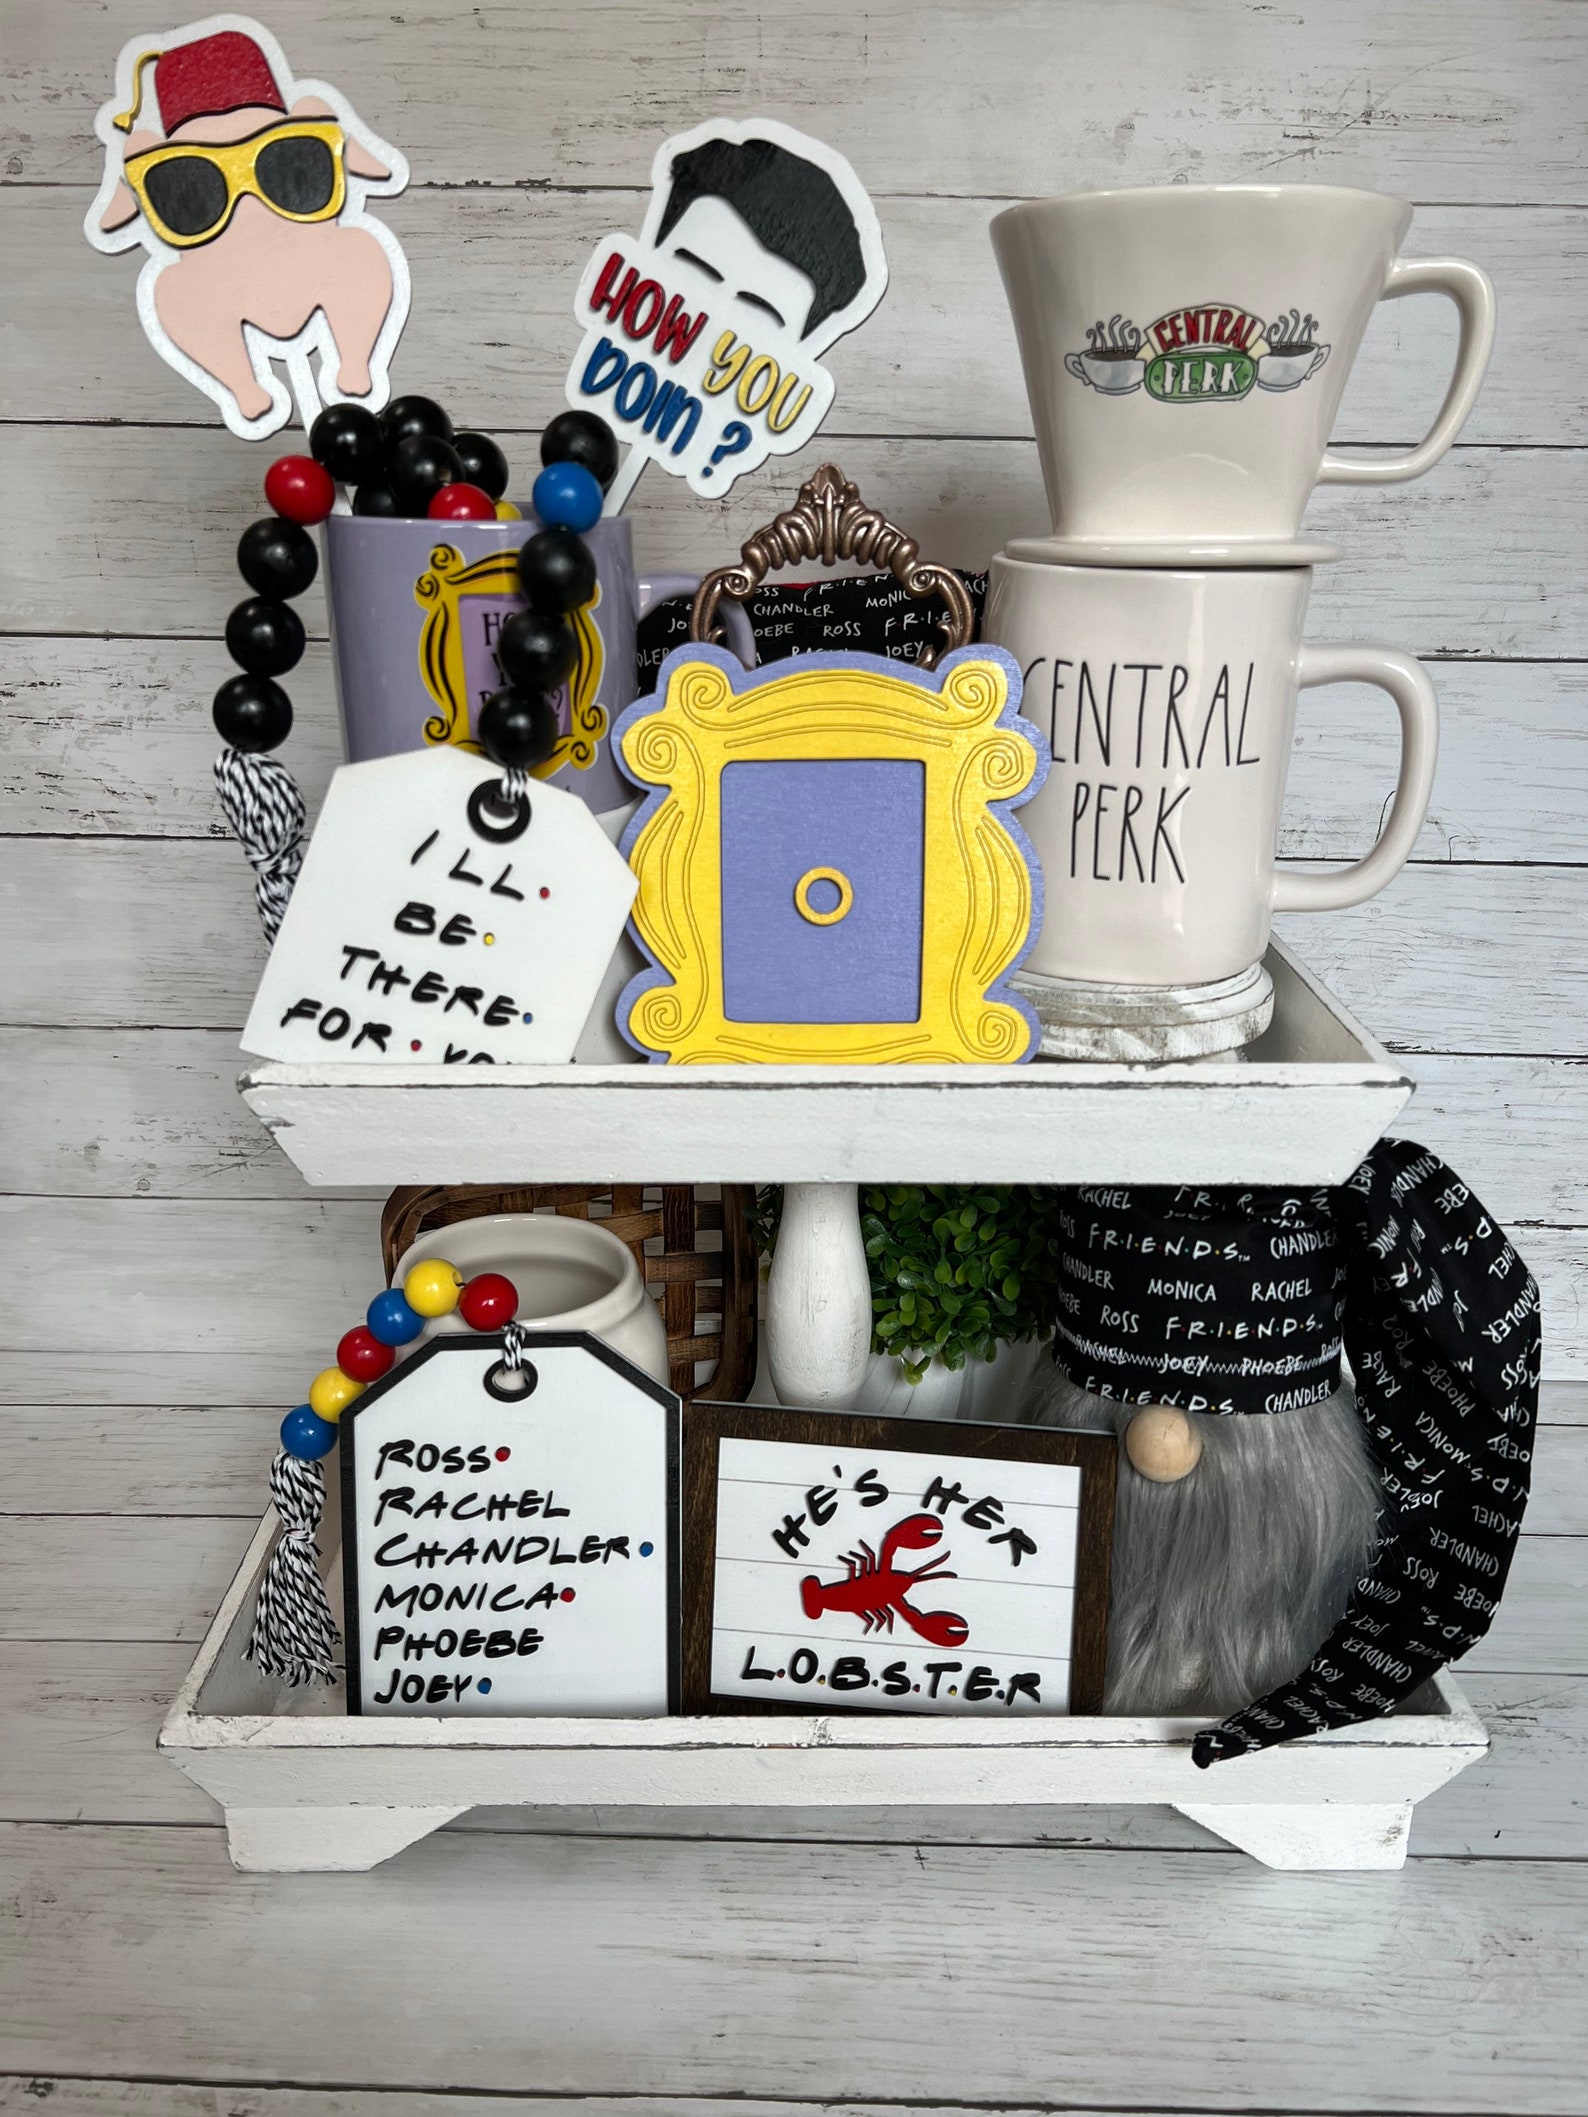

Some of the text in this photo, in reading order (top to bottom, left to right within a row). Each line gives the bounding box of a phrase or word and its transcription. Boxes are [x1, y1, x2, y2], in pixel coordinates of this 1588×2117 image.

[589, 252, 814, 433] HOW YOU
[1153, 309, 1257, 354] CENTRAL
[1162, 360, 1243, 395] PERK
[754, 603, 834, 617] CHANDLER
[823, 621, 861, 637] ROSS
[1070, 783, 1191, 884] PERK
[1078, 1185, 1132, 1210] RACHEL
[1147, 1277, 1217, 1303] MONICA
[1251, 1277, 1312, 1303] RACHEL
[1100, 1304, 1140, 1334] ROSS
[1158, 1352, 1209, 1378] JOEY
[1241, 1353, 1304, 1377] PHOEBE
[1265, 1378, 1331, 1415] CHANDLER
[1422, 1359, 1476, 1417] PHOEBE
[1416, 1411, 1471, 1464] MONICA
[374, 1486, 571, 1527] RACHEL
[772, 1465, 1038, 1567] HE'S HER
[1430, 1526, 1499, 1577] CHANDLER
[1402, 1556, 1440, 1589] ROSS
[374, 1626, 544, 1661] PHOEBE
[1350, 1614, 1391, 1637] JOEY
[1342, 1637, 1413, 1683] CHANDLER
